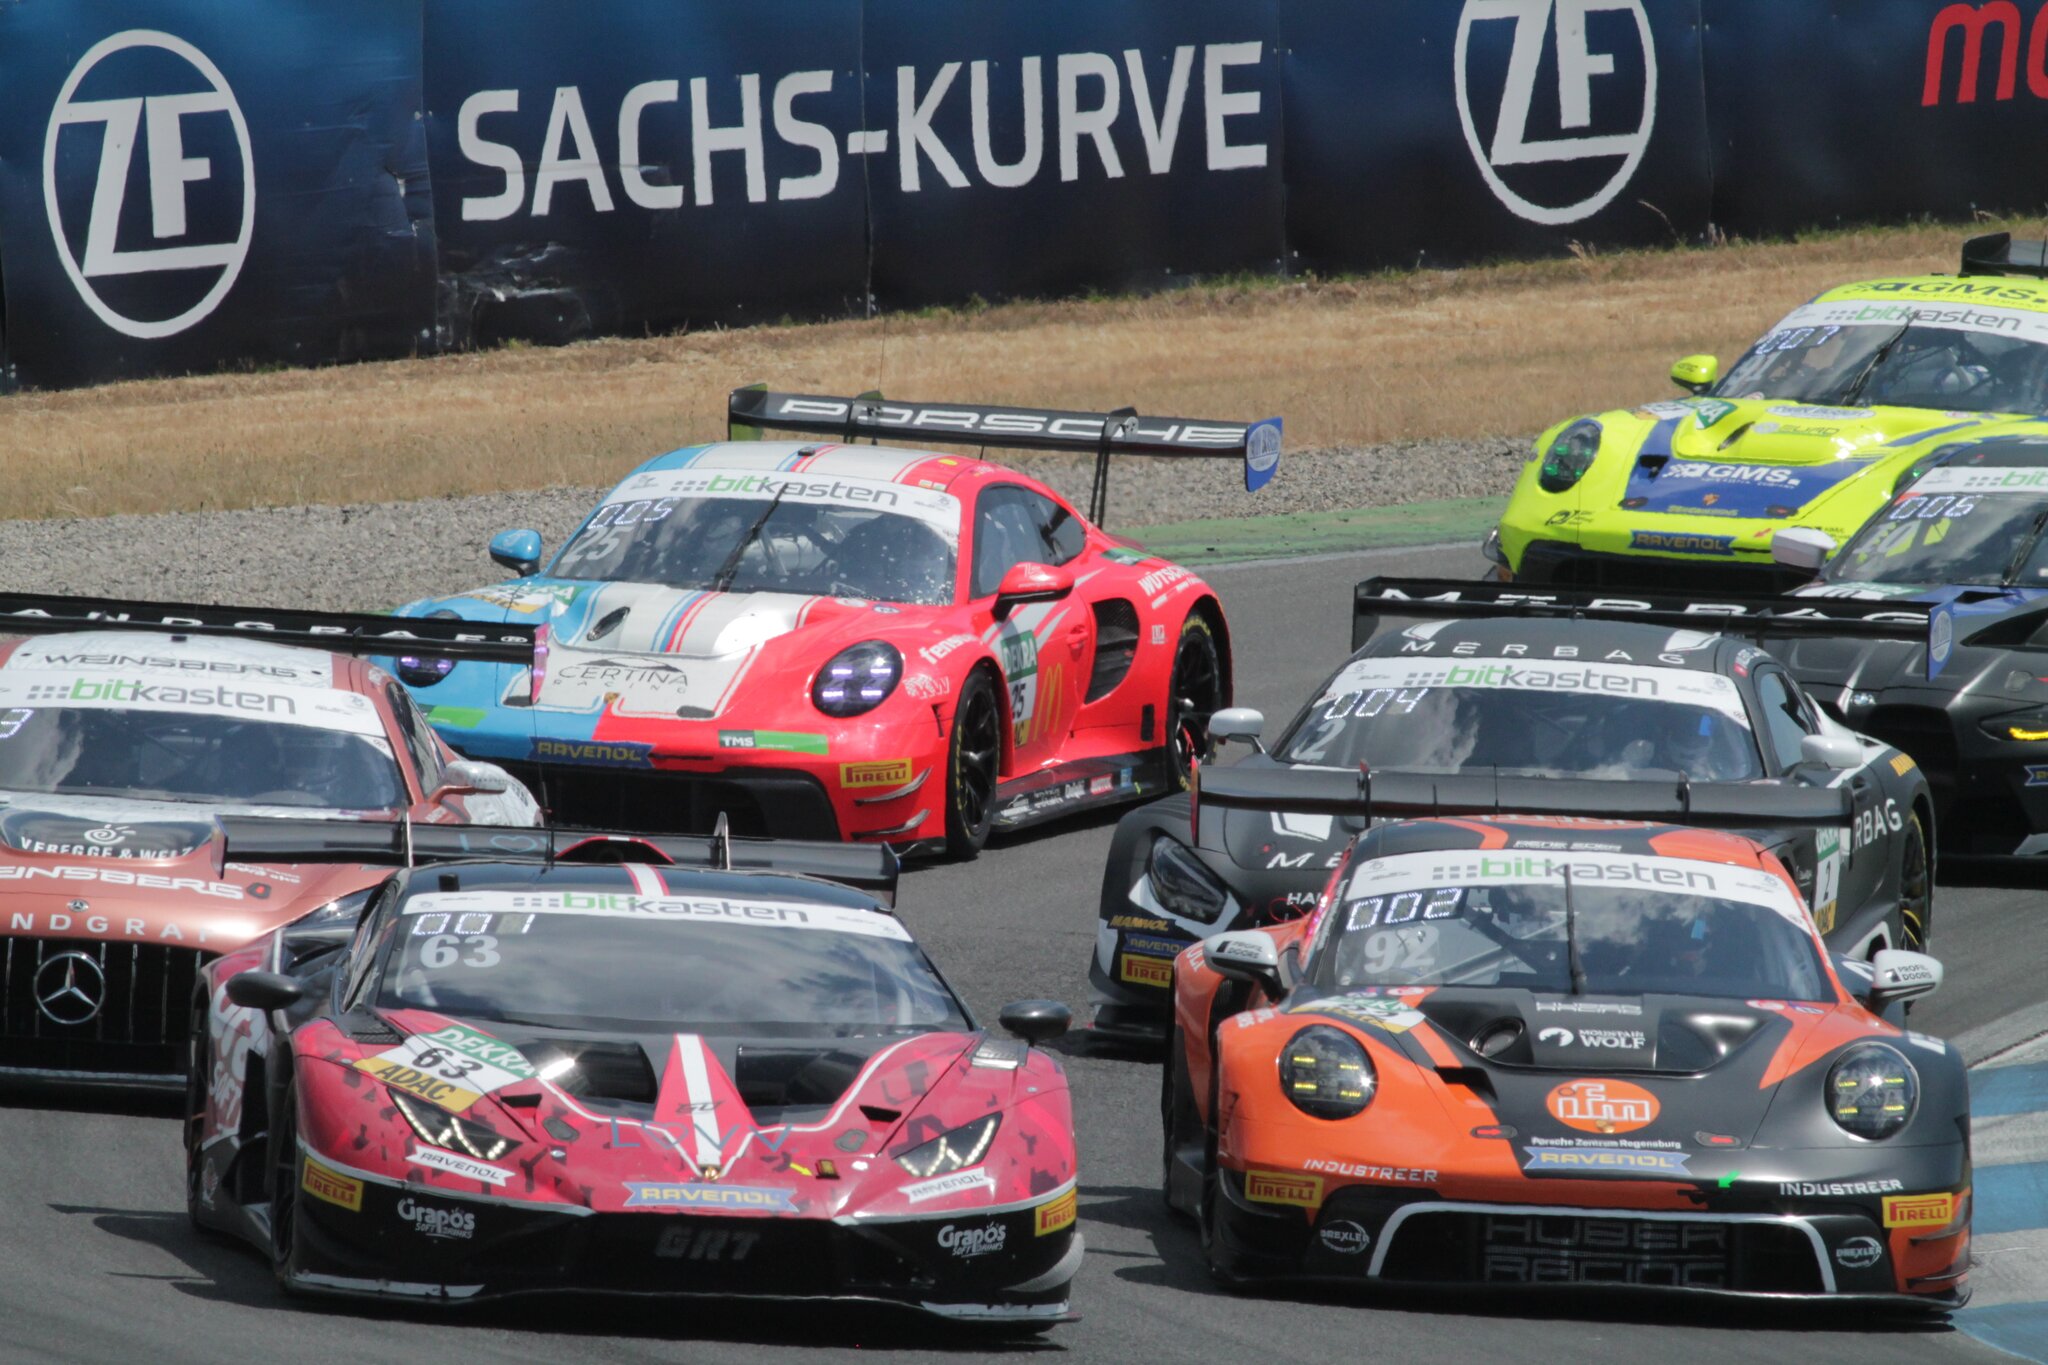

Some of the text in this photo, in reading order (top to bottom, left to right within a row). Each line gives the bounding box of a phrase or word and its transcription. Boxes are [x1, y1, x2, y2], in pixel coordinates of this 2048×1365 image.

[458, 41, 1268, 222] SACHS-KURVE
[1855, 305, 2022, 331] bitkasten
[706, 474, 899, 506] bitkasten
[1636, 533, 1724, 550] RAVENOL
[1401, 640, 1685, 665] MERBAG
[45, 654, 298, 677] WEINSBERG
[559, 666, 688, 686] CERTINA
[1444, 665, 1659, 695] bitkasten
[71, 678, 296, 714] bitkasten
[1324, 688, 1428, 719] 004
[537, 741, 642, 761] RAVENOL
[721, 736, 754, 747] TMS
[845, 762, 907, 783] PIRELLI
[1481, 857, 1716, 891] bitkasten
[562, 891, 809, 923] bitkasten
[1346, 888, 1463, 931] 002
[420, 934, 501, 968] 63
[1364, 925, 1440, 974] 92
[1902, 971, 1932, 981] DOORS
[1579, 1028, 1644, 1038] MOUNTAIN
[1579, 1035, 1645, 1049] WOLF
[412, 1047, 483, 1080] 63
[433, 1028, 537, 1077] DEKRA
[375, 1064, 455, 1101] ADAC
[1531, 1136, 1681, 1149] Porsche Zentrum Regensburg
[420, 1151, 500, 1180] RAVENOL
[1304, 1159, 1437, 1183] INDUSTREER
[1540, 1152, 1675, 1168] RAVENOL
[306, 1163, 357, 1205] PIRELLI
[640, 1187, 780, 1205] RAVENOL
[912, 1174, 985, 1197] RAVENOL
[1250, 1174, 1315, 1200] PIRELLI
[1780, 1178, 1903, 1196] INDUSTREER
[1889, 1199, 1949, 1222] PIRELLI
[415, 1222, 436, 1232] SOFT
[1486, 1217, 1727, 1249] HUBER
